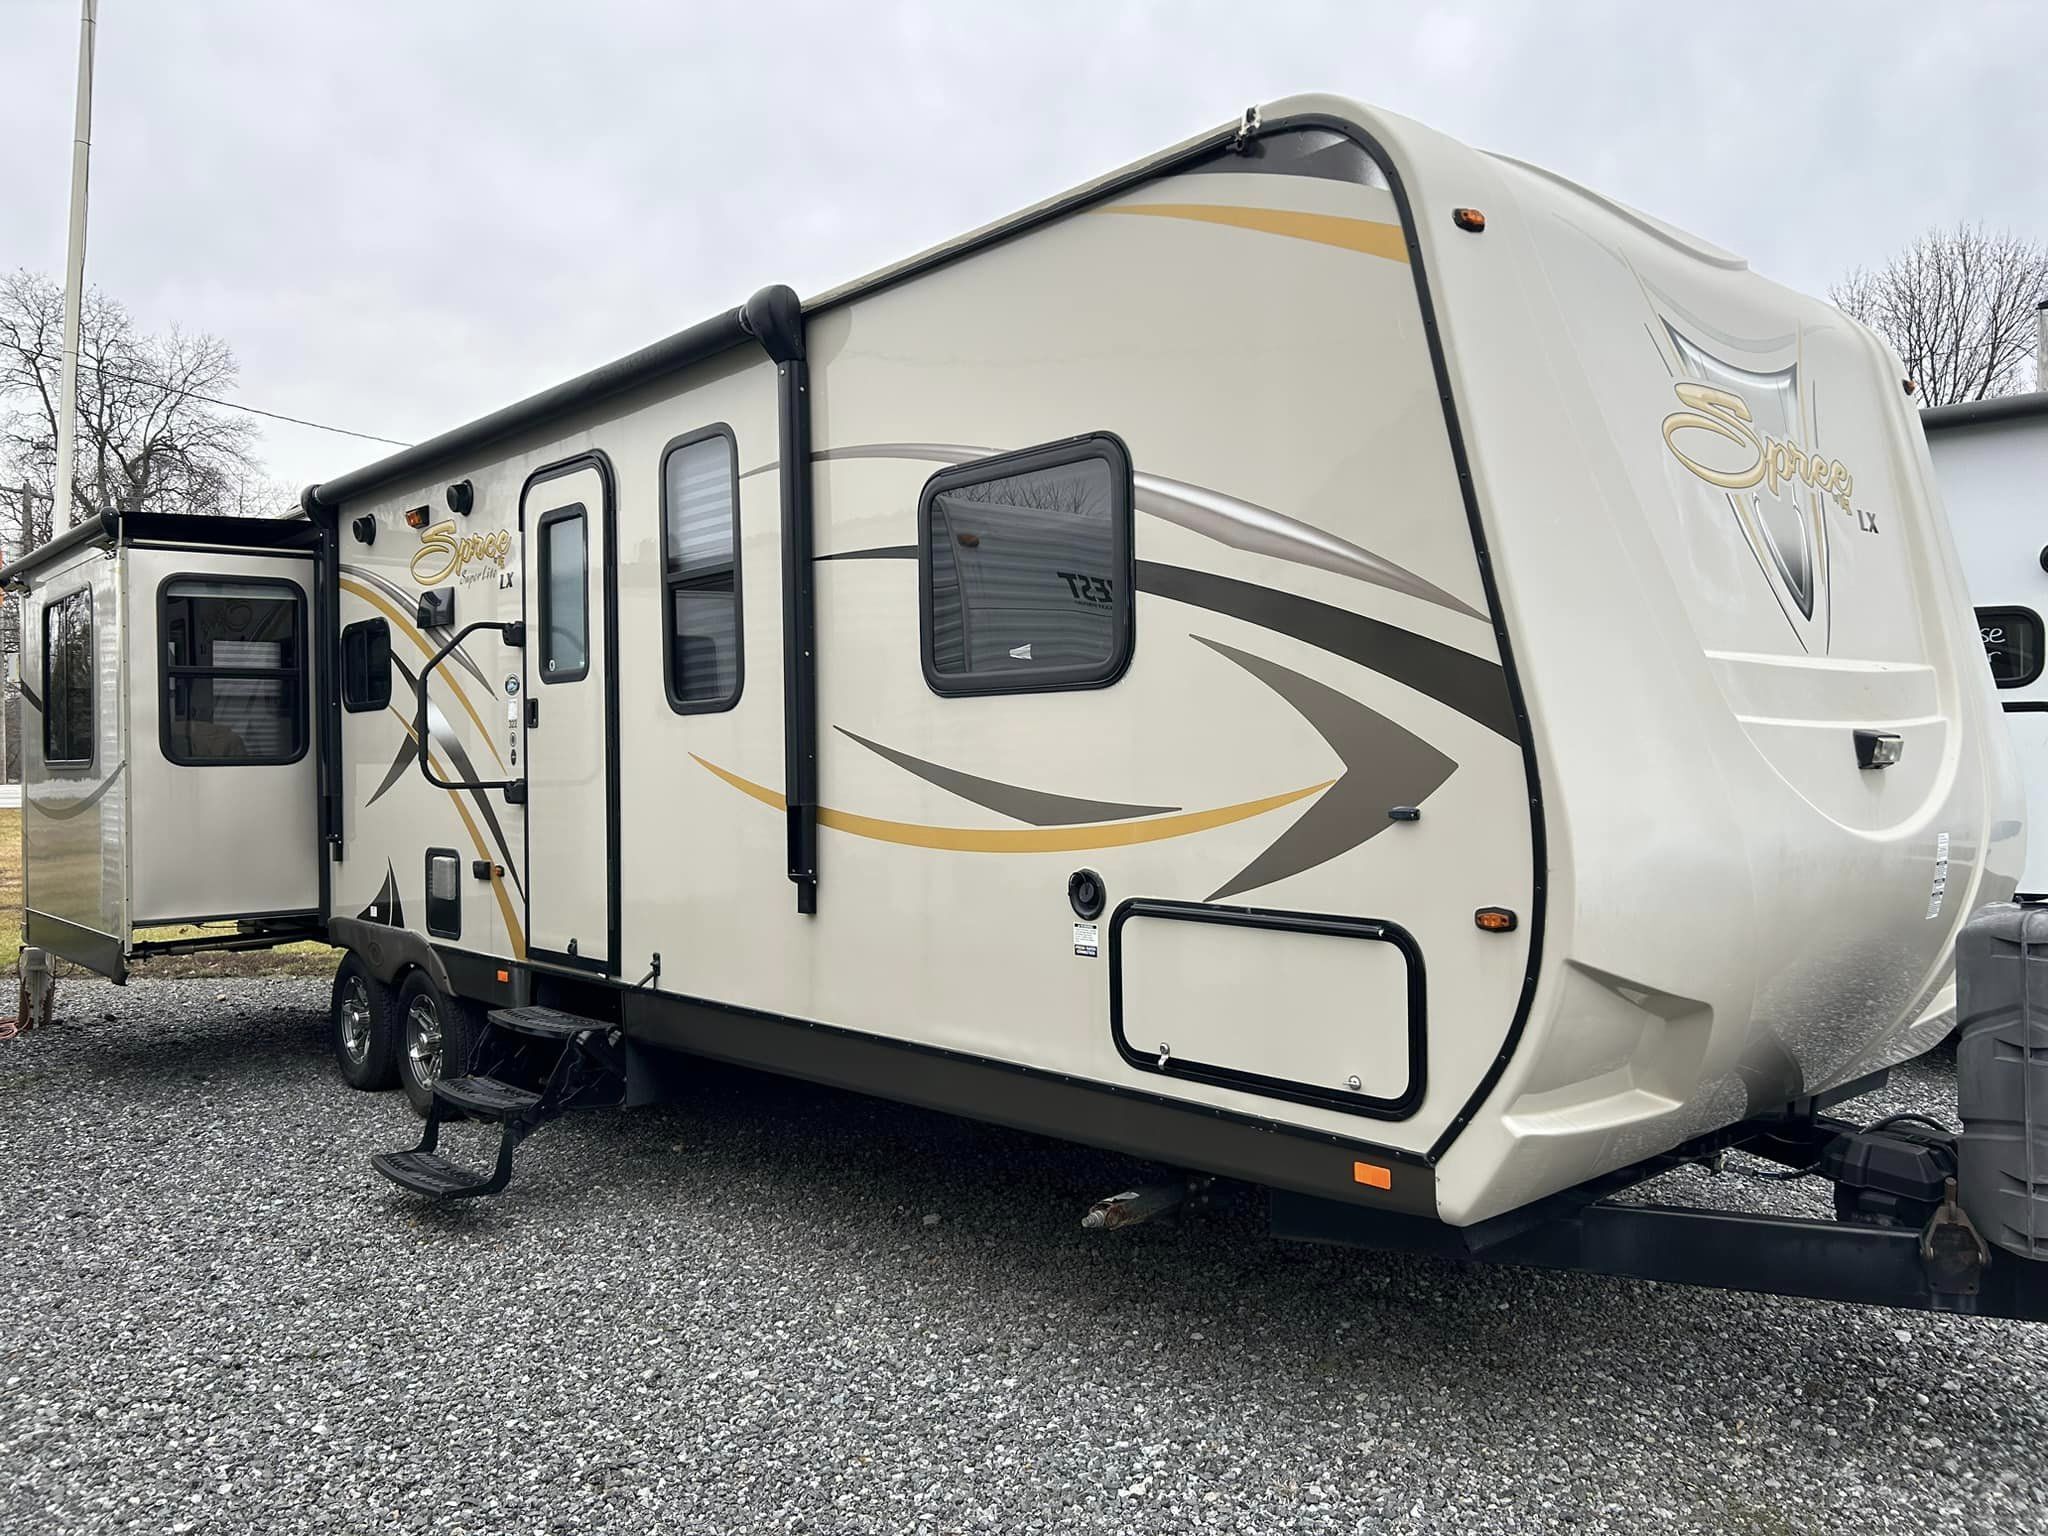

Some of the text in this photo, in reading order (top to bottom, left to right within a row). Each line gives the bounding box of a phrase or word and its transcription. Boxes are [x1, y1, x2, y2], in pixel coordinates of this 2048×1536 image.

[1662, 382, 1853, 496] Spree
[1856, 509, 1879, 534] LX
[410, 518, 512, 586] Spree
[499, 571, 514, 590] LX
[1980, 627, 2006, 643] se
